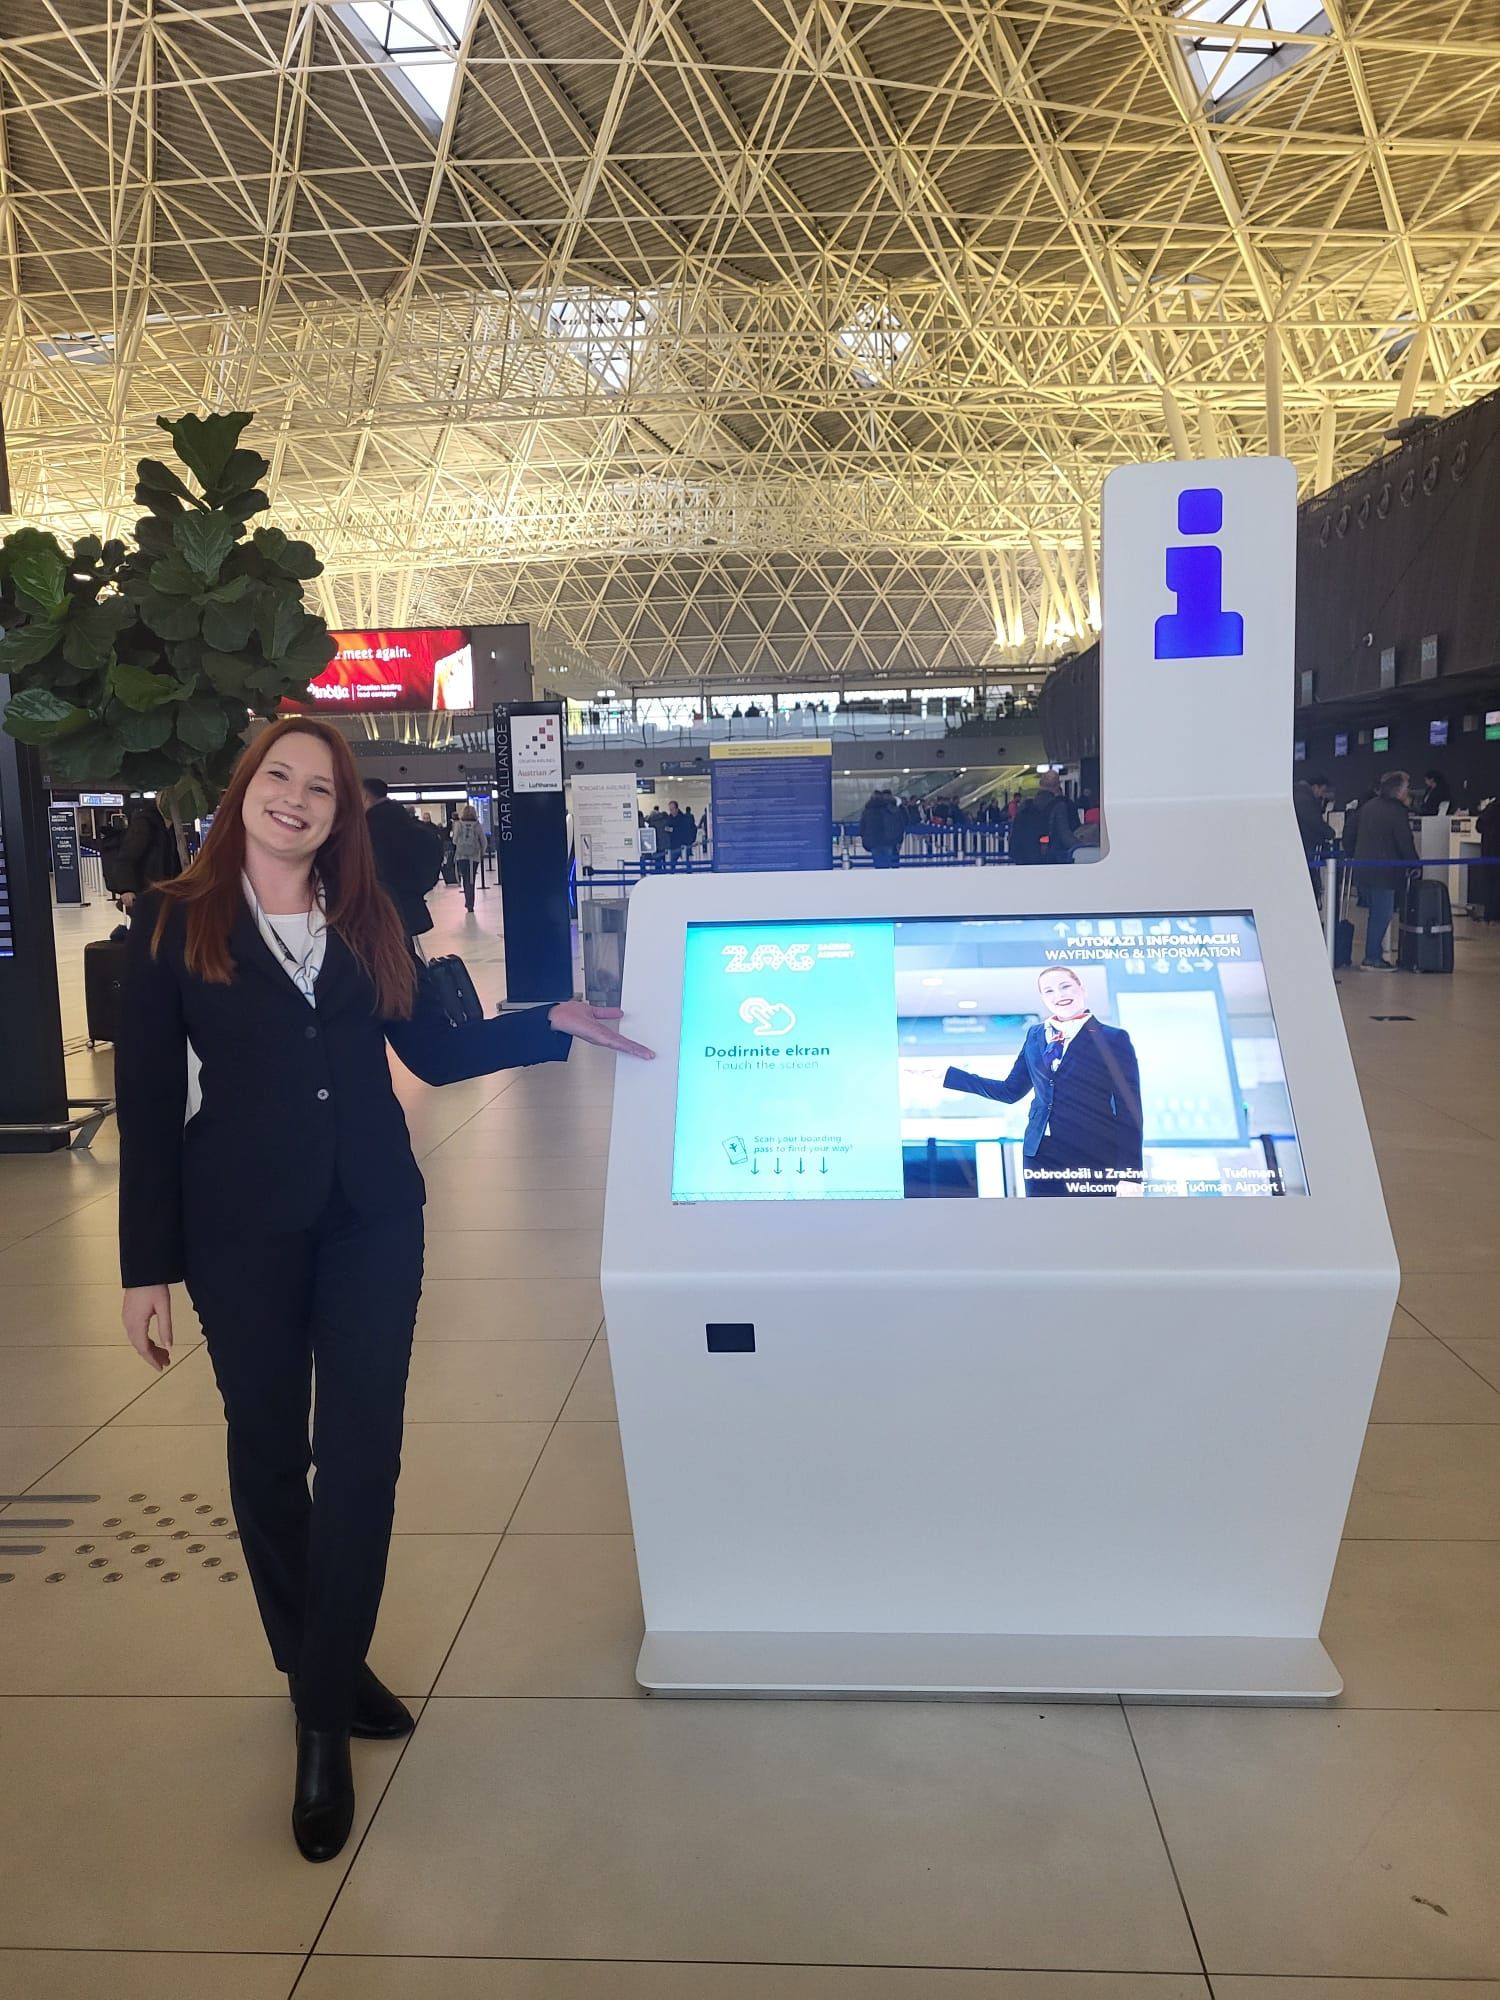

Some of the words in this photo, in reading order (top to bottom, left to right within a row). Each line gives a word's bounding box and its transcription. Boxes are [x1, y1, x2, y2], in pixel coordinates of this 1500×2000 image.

[343, 648, 374, 660] meet
[375, 645, 412, 662] again.
[497, 723, 510, 798] ALLIANCE
[517, 769, 547, 777] Austrian
[501, 803, 513, 841] STAR
[1067, 936, 1135, 947] PUTOKAZI
[1147, 934, 1239, 946] INFORMACIJE
[1045, 949, 1129, 961] WAYFINDING
[1132, 949, 1144, 960] &
[1147, 946, 1241, 960] INFORMATION
[704, 1045, 780, 1058] Dodirnite
[785, 1044, 830, 1056] ekran
[715, 1060, 752, 1071] Touch
[757, 1060, 776, 1070] the
[777, 1136, 797, 1144] your
[800, 1135, 842, 1143] boarding
[788, 1145, 806, 1153] find
[809, 1146, 829, 1154] your
[1023, 1168, 1091, 1179] Dobrodošli
[1094, 1170, 1103, 1179] u
[1235, 1181, 1278, 1194] Airport
